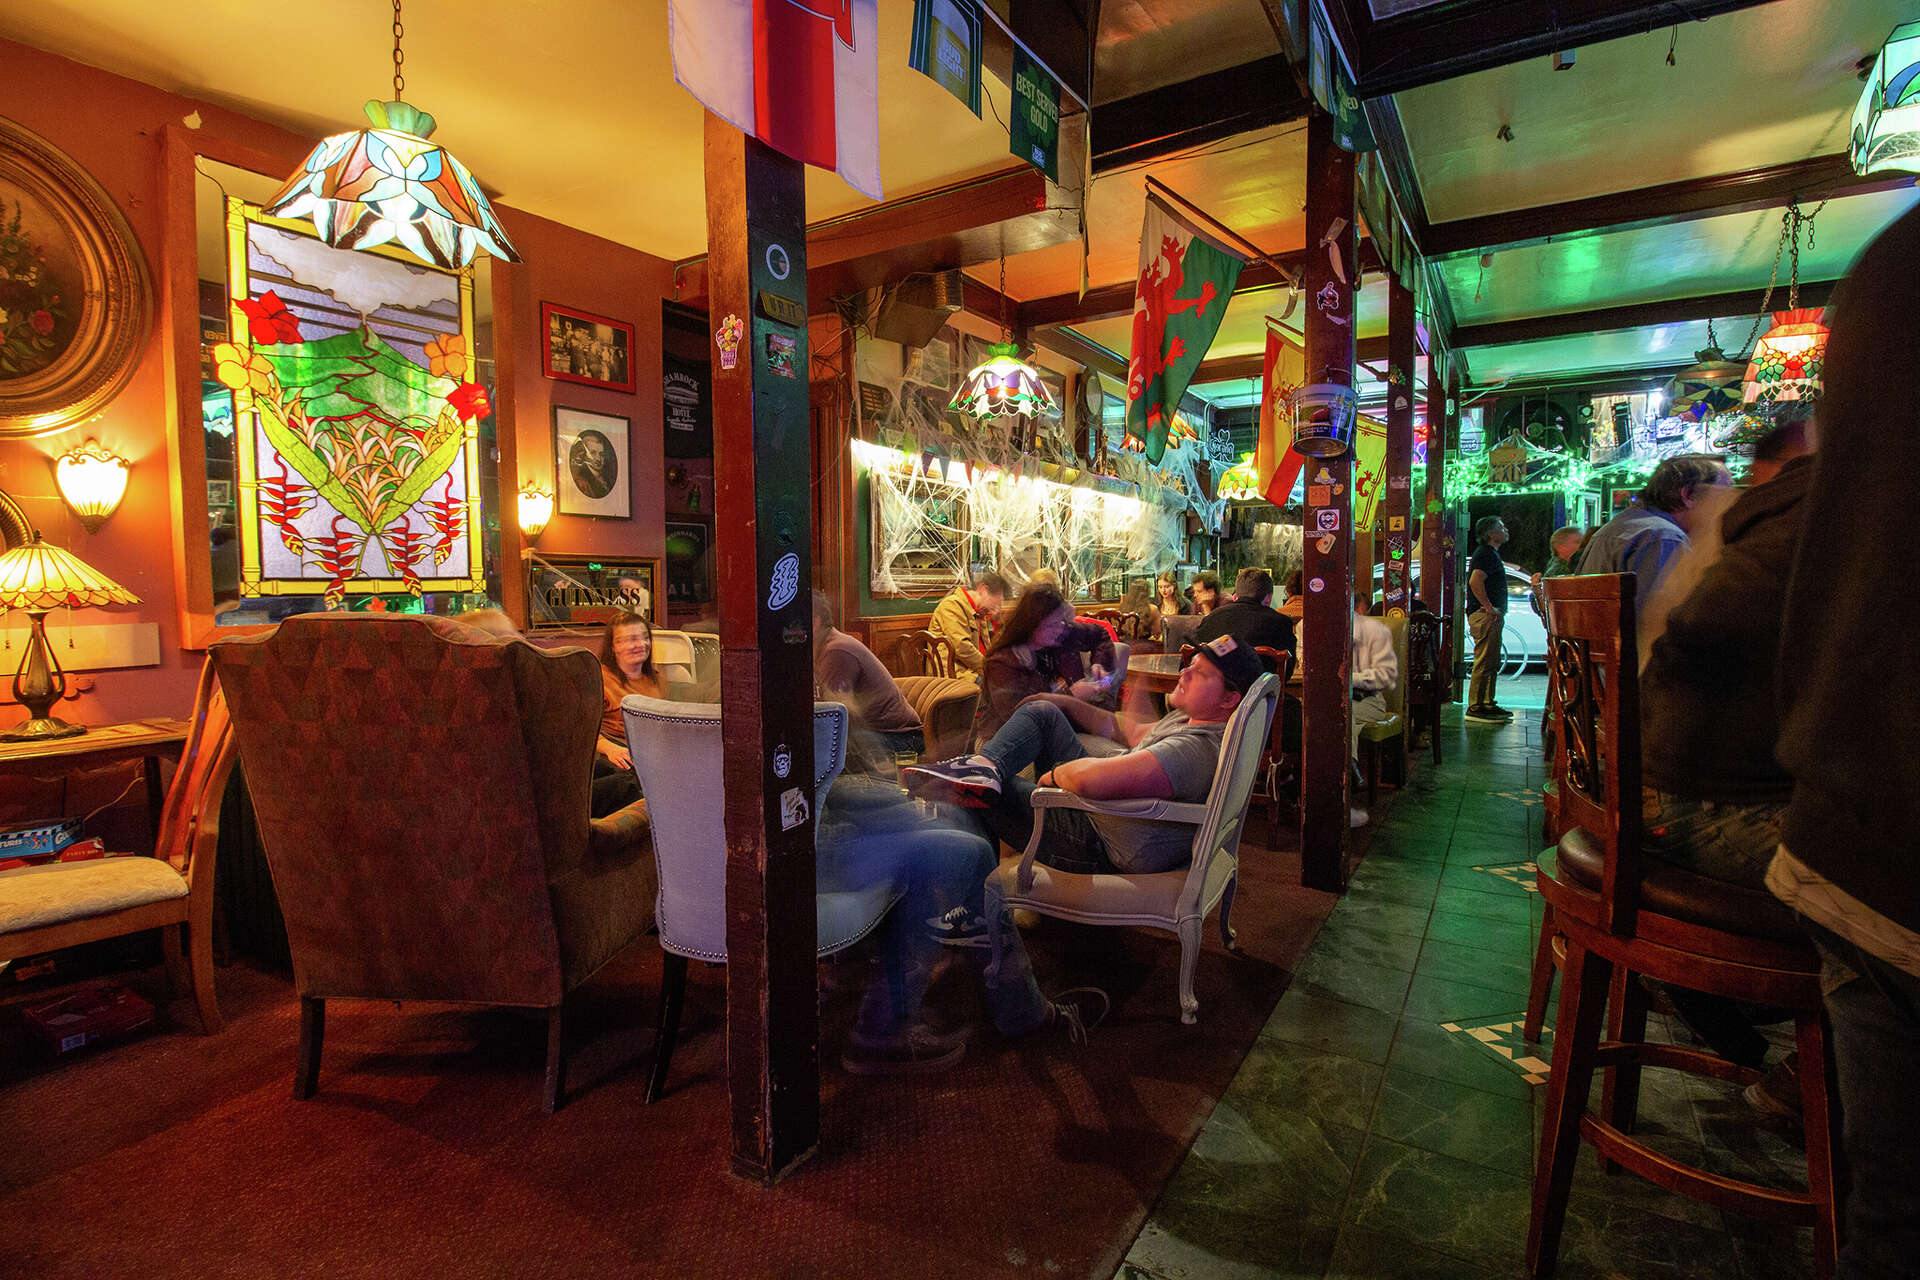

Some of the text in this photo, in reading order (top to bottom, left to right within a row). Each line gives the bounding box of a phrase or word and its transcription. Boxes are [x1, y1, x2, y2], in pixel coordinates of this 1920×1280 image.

[938, 47, 964, 81] LIGHT
[942, 38, 961, 65] BUD
[1016, 72, 1058, 123] BEST SERVED
[1030, 105, 1048, 133] GOLD
[663, 370, 699, 391] HAMROCK
[545, 587, 641, 608] GUINNESS
